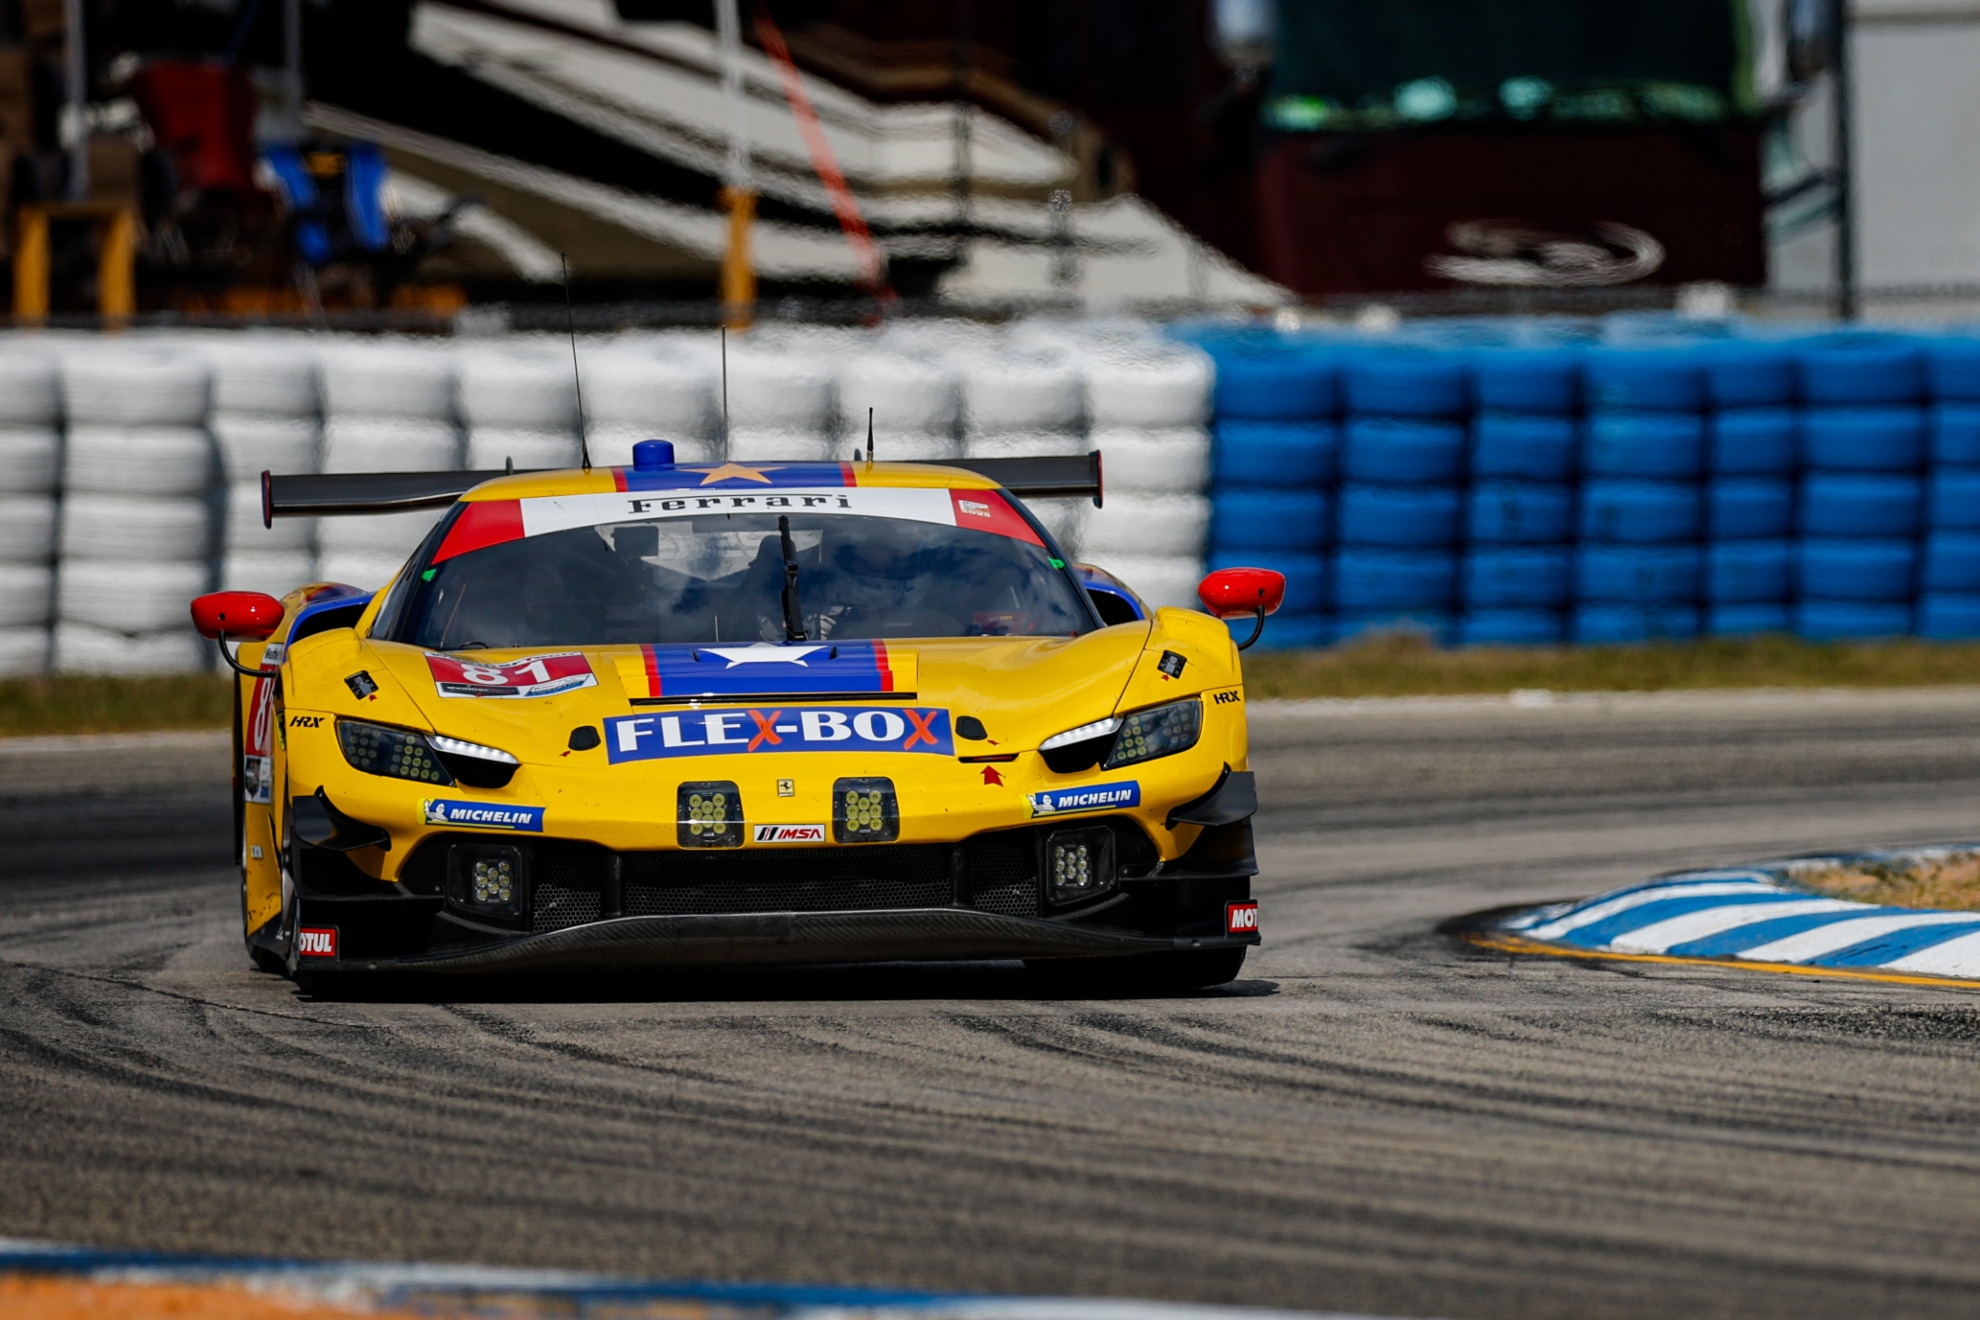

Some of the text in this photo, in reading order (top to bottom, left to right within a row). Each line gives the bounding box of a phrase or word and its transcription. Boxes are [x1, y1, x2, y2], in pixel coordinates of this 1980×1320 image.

[628, 494, 852, 514] Ferrari
[460, 660, 552, 685] 81
[1213, 691, 1241, 704] HRX
[289, 716, 325, 728] HRX
[616, 709, 938, 752] FLEX-BOX
[1058, 789, 1132, 808] MICHELIN
[450, 808, 533, 824] MICHELIN
[777, 828, 822, 840] IMSA
